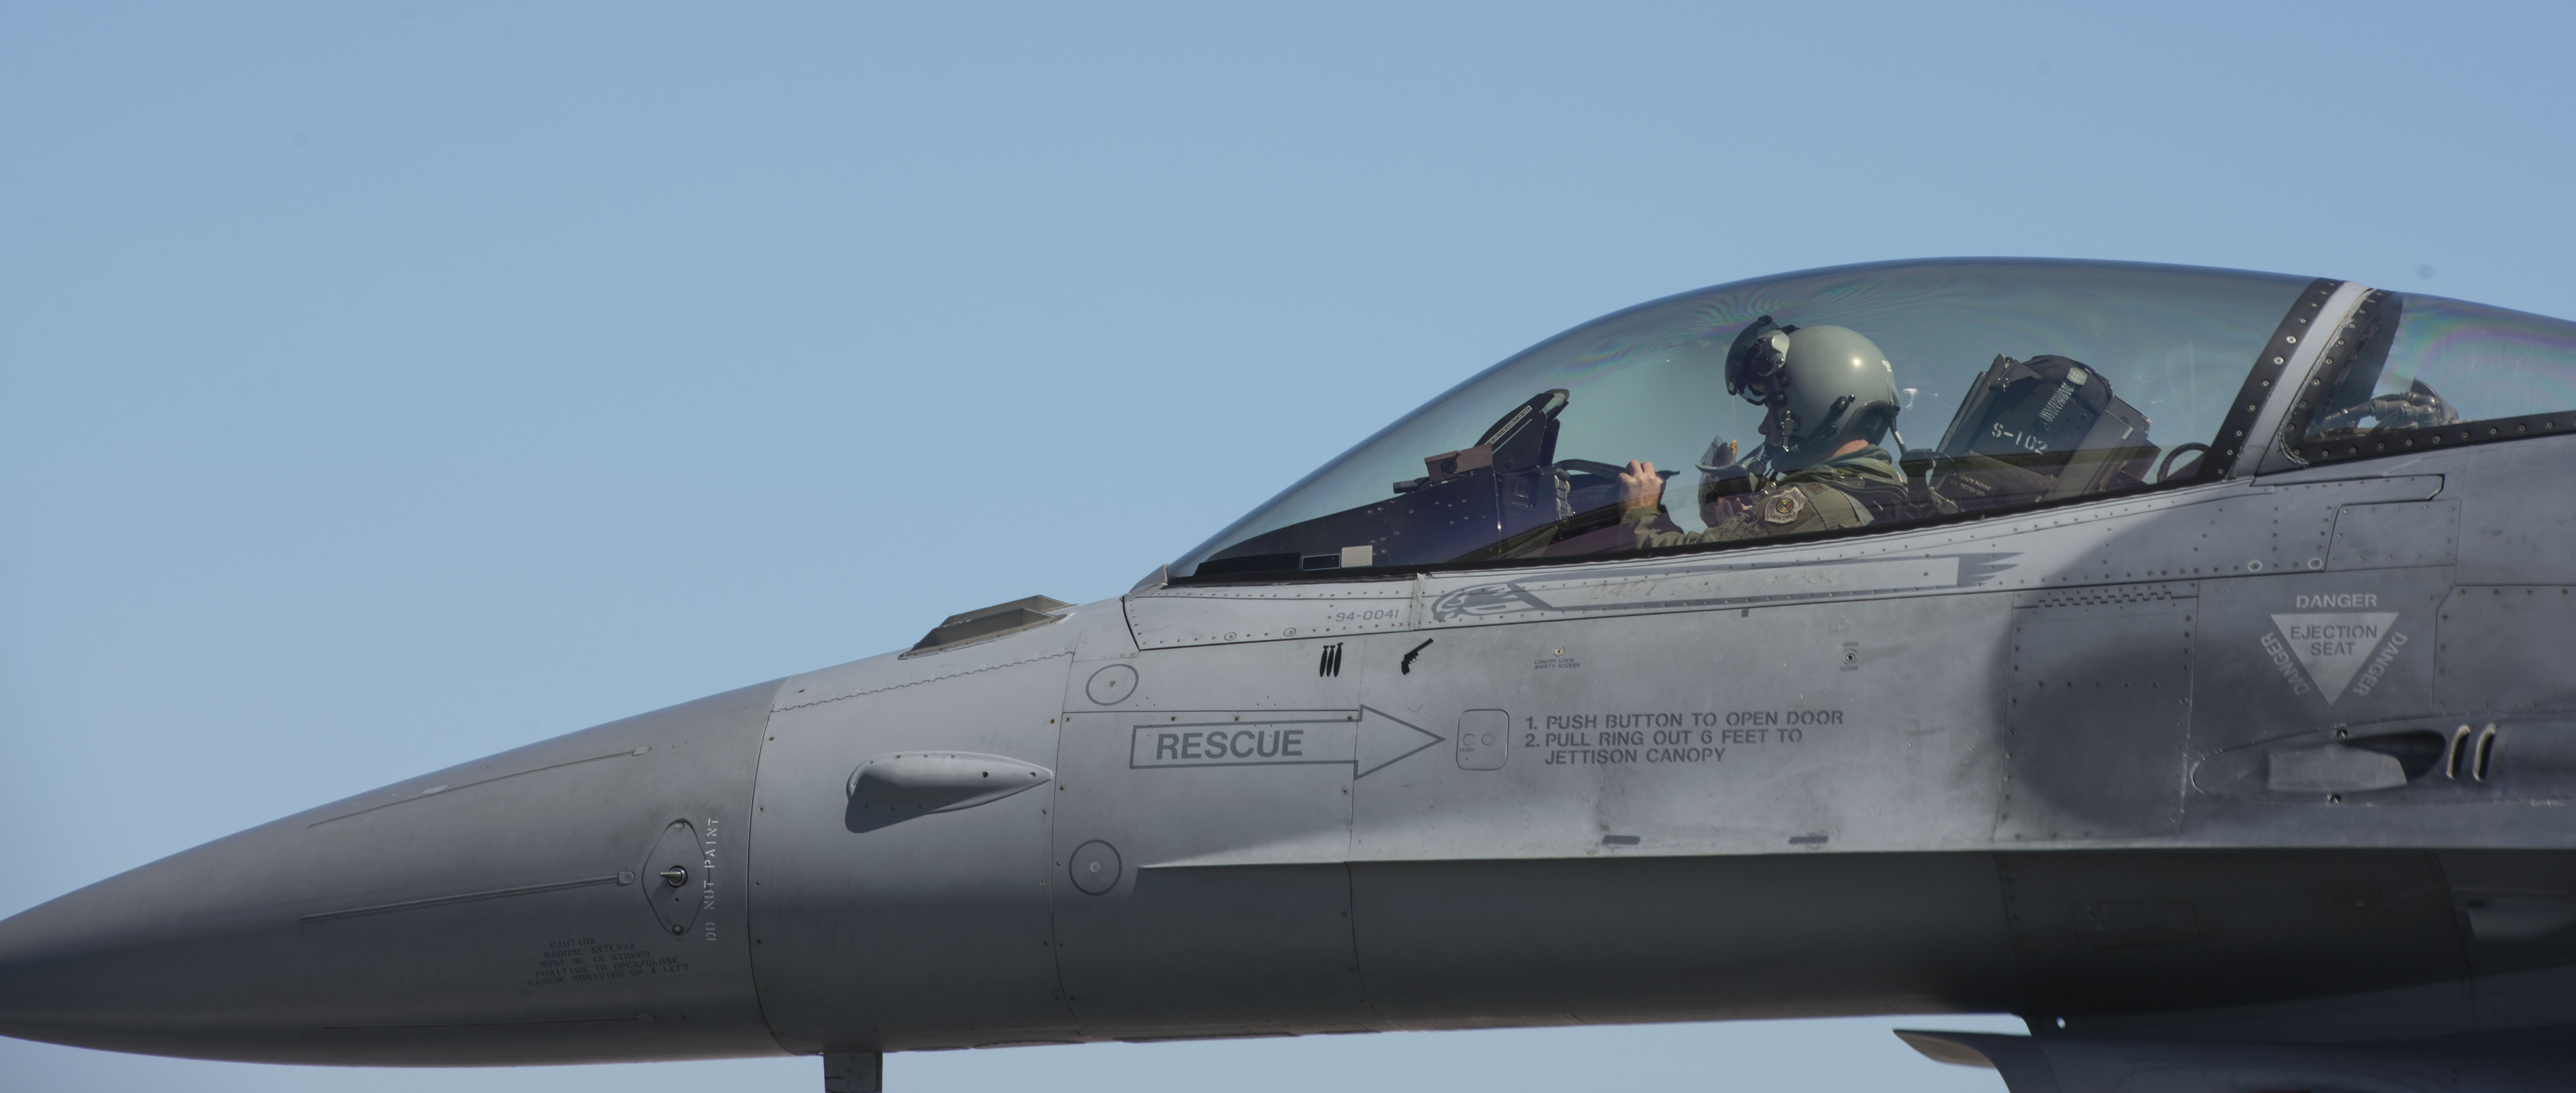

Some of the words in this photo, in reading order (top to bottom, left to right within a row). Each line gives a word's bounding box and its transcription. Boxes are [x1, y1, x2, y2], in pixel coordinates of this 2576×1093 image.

[1992, 423, 2047, 455] S-102
[2296, 594, 2377, 608] DANGER
[1336, 610, 1398, 622] 94-0041
[2291, 625, 2377, 640] EJECTION
[2311, 641, 2356, 656] SEAT
[2261, 631, 2311, 697] DANGER
[2353, 631, 2409, 696] DANGER
[1526, 717, 1537, 730] 1.
[1547, 715, 1597, 729] PUSH
[1606, 713, 1682, 728] BUTTON
[1691, 712, 1717, 727] TO
[1726, 712, 1777, 726] OPEN
[1787, 711, 1843, 725] DOOR
[1156, 730, 1303, 759] RESCUE
[1525, 733, 1540, 748] 2.
[1546, 733, 1590, 747] PULL
[1599, 731, 1644, 746] RING
[1653, 731, 1692, 745] OUT
[1701, 730, 1712, 744] 6
[1722, 730, 1769, 744] FEET
[1777, 729, 1803, 743] TO
[1545, 750, 1637, 765] JETTISON
[1646, 748, 1726, 762] CANOPY
[704, 818, 719, 868] PAINT
[704, 880, 715, 910] NOT
[705, 922, 716, 941] DO
[544, 947, 583, 959] RADOME
[591, 943, 635, 953] ANTENNA
[551, 938, 596, 949] CAUTION
[535, 967, 587, 978] POSITION
[539, 959, 564, 968] MUST
[527, 976, 566, 986] RADOME
[572, 970, 625, 982] POSITION
[662, 963, 689, 973] LEFT
